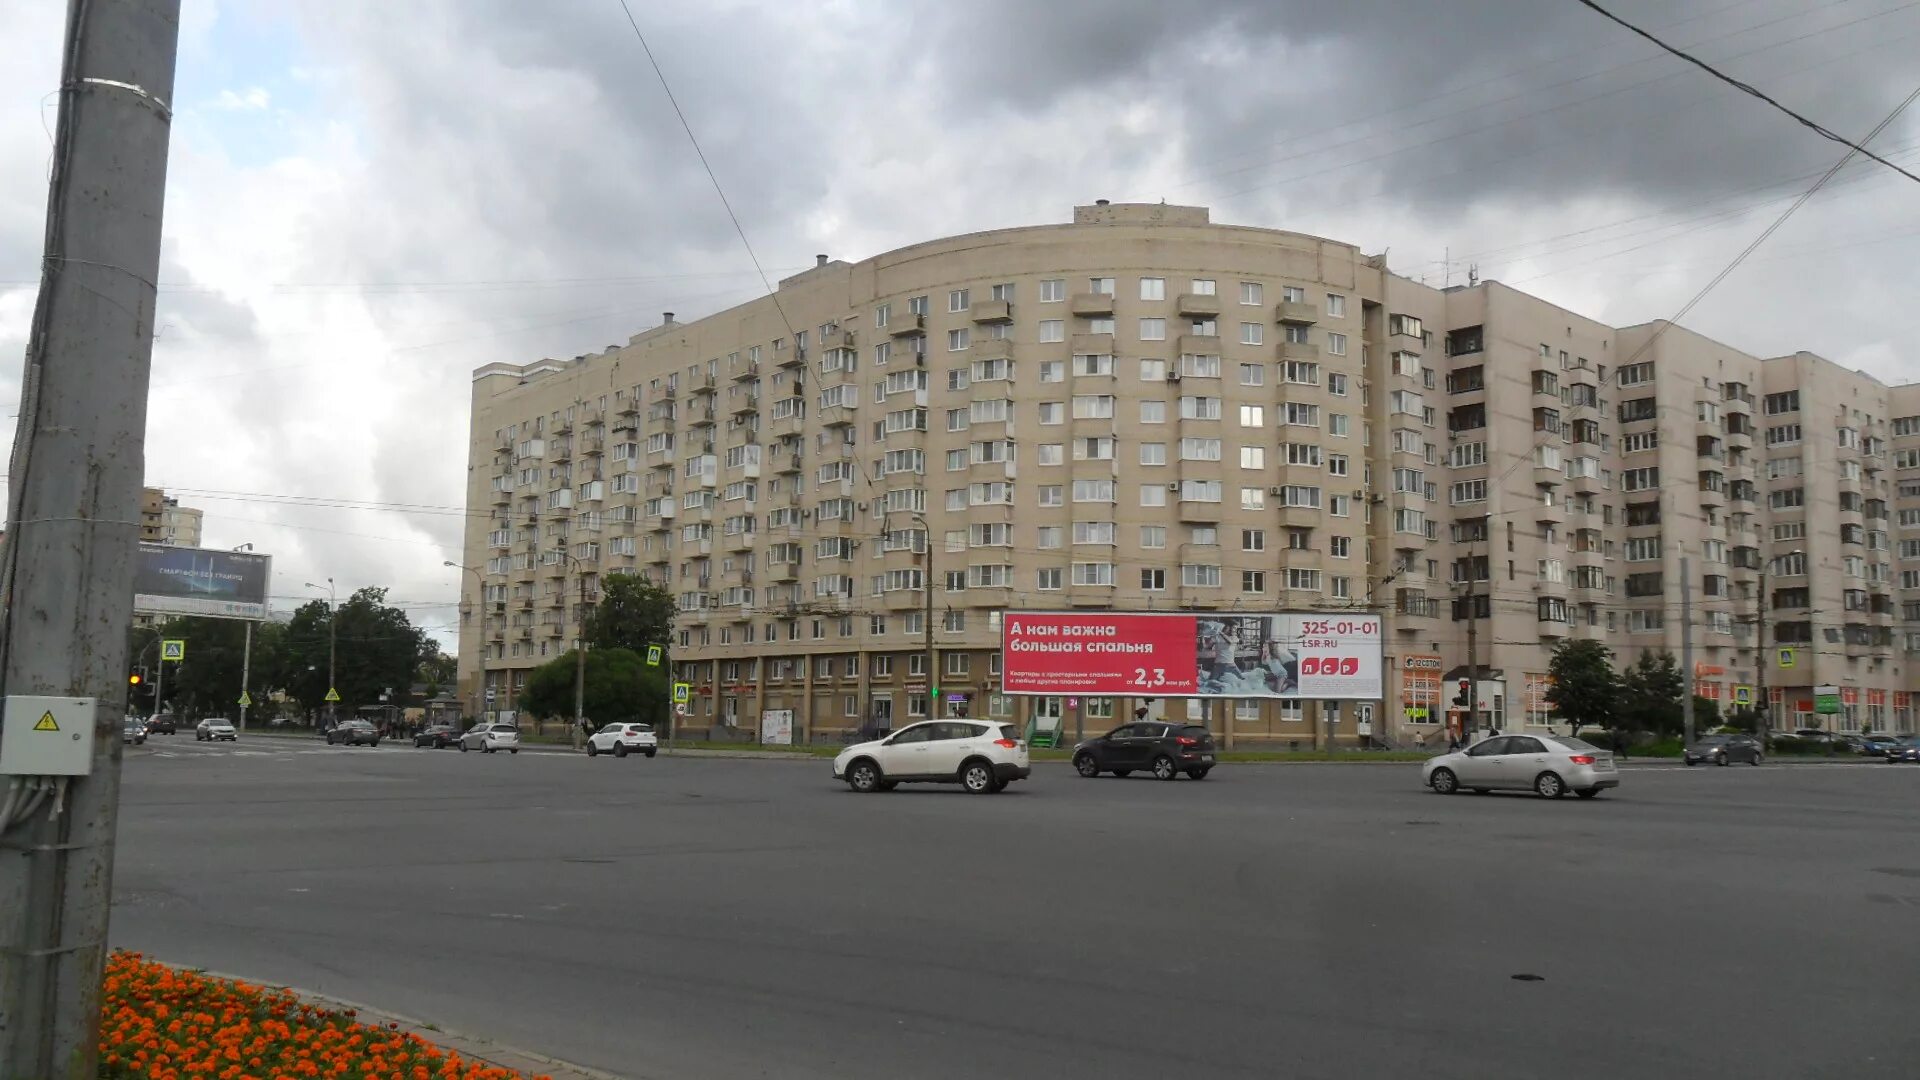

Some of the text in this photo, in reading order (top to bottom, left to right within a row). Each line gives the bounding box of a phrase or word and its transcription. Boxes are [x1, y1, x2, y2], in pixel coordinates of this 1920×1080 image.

[1010, 621, 1116, 636] А нам важна
[1302, 621, 1378, 634] 325-01-01
[1010, 639, 1153, 653] большая спальня
[1302, 639, 1338, 648] LSR.RU
[1010, 670, 1040, 678] Квартиры
[1134, 668, 1165, 688] 2,3
